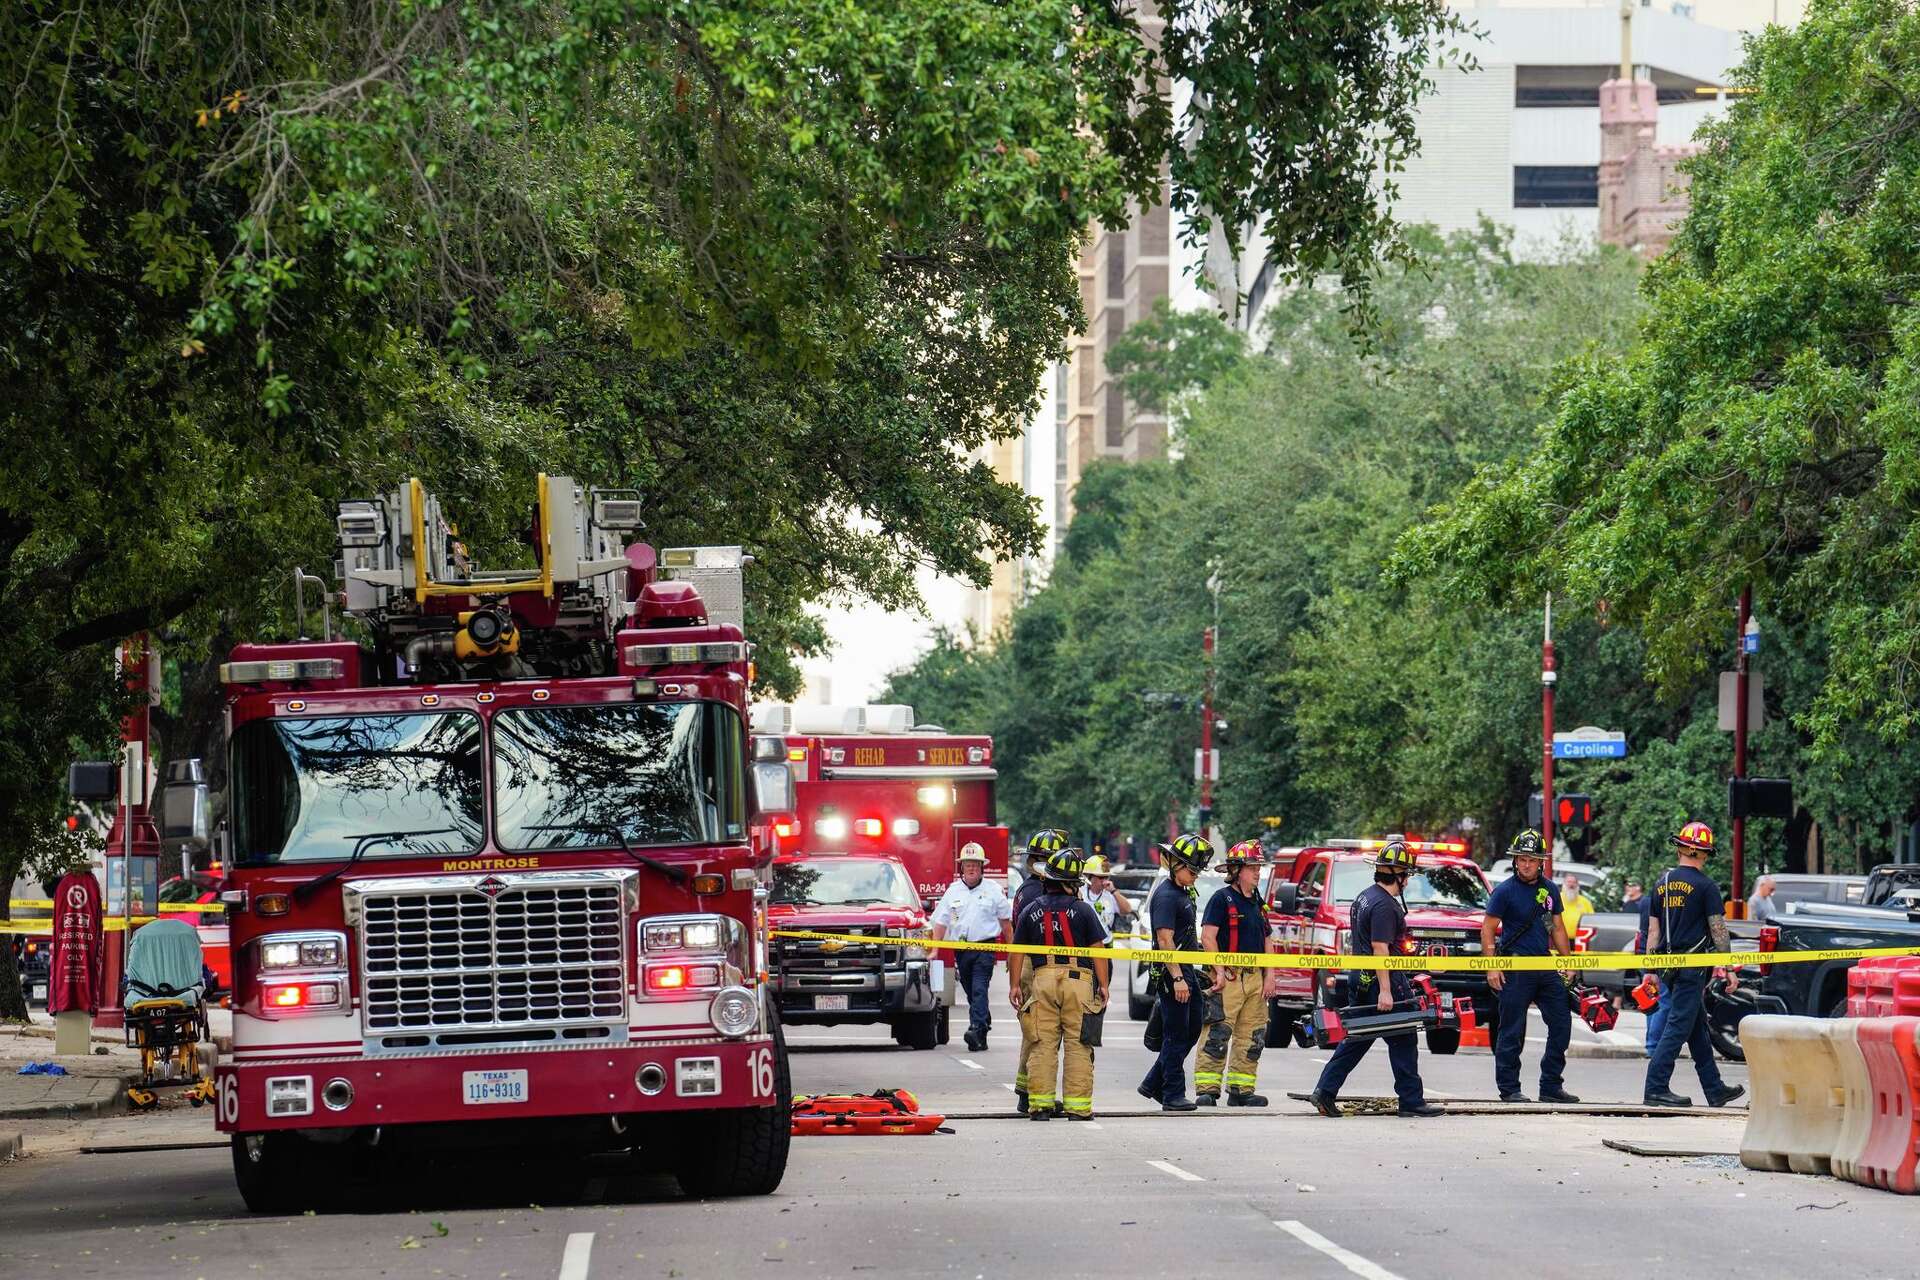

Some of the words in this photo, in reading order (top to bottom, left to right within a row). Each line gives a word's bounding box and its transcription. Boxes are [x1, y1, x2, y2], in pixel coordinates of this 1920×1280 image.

[1563, 743, 1615, 755] Caroline
[854, 747, 885, 766] REHAB
[929, 747, 965, 765] SERVICES
[443, 857, 540, 871] MONTROSE
[919, 883, 946, 893] RA-24
[883, 939, 927, 948] CAUTION
[482, 1072, 509, 1080] TEXAS
[747, 1047, 774, 1098] 16
[469, 1082, 521, 1099] 116-9318
[215, 1073, 240, 1124] 16
